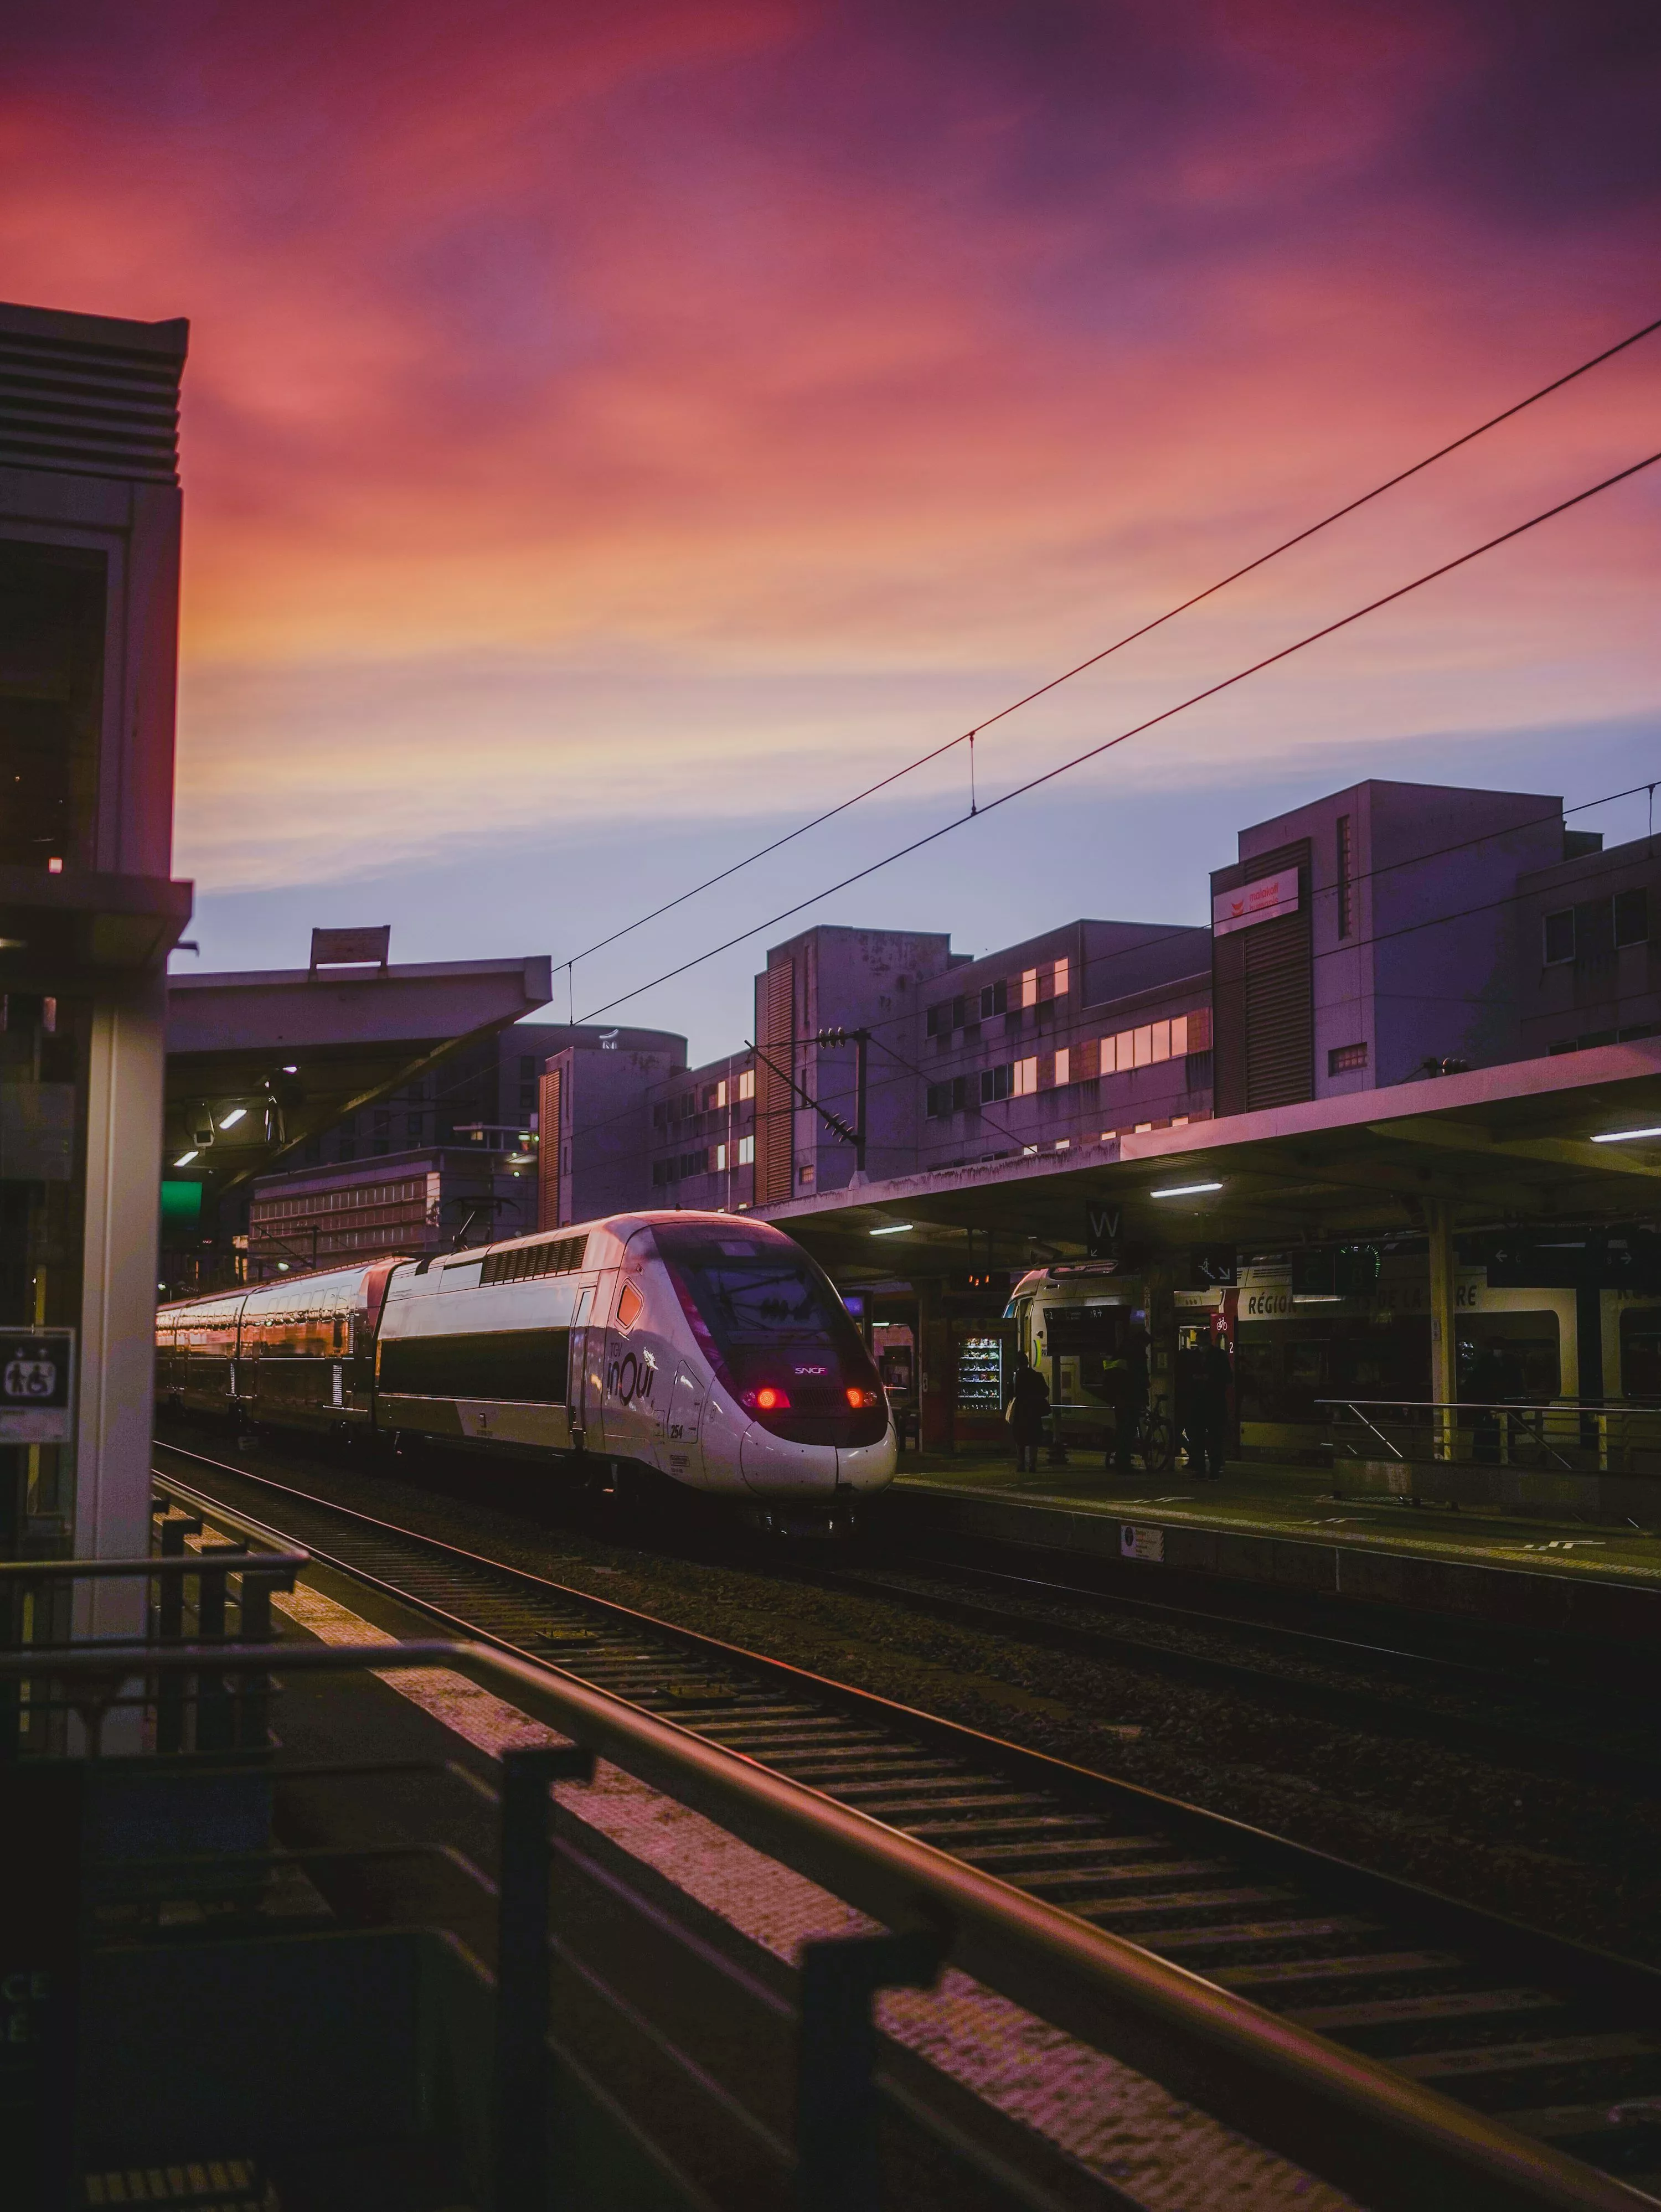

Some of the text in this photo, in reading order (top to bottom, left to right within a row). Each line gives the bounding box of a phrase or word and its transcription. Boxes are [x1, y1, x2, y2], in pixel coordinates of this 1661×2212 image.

[1089, 1211, 1120, 1238] W
[610, 1342, 623, 1357] TGV
[1229, 1341, 1234, 1353] 2
[670, 1424, 683, 1439] 254
